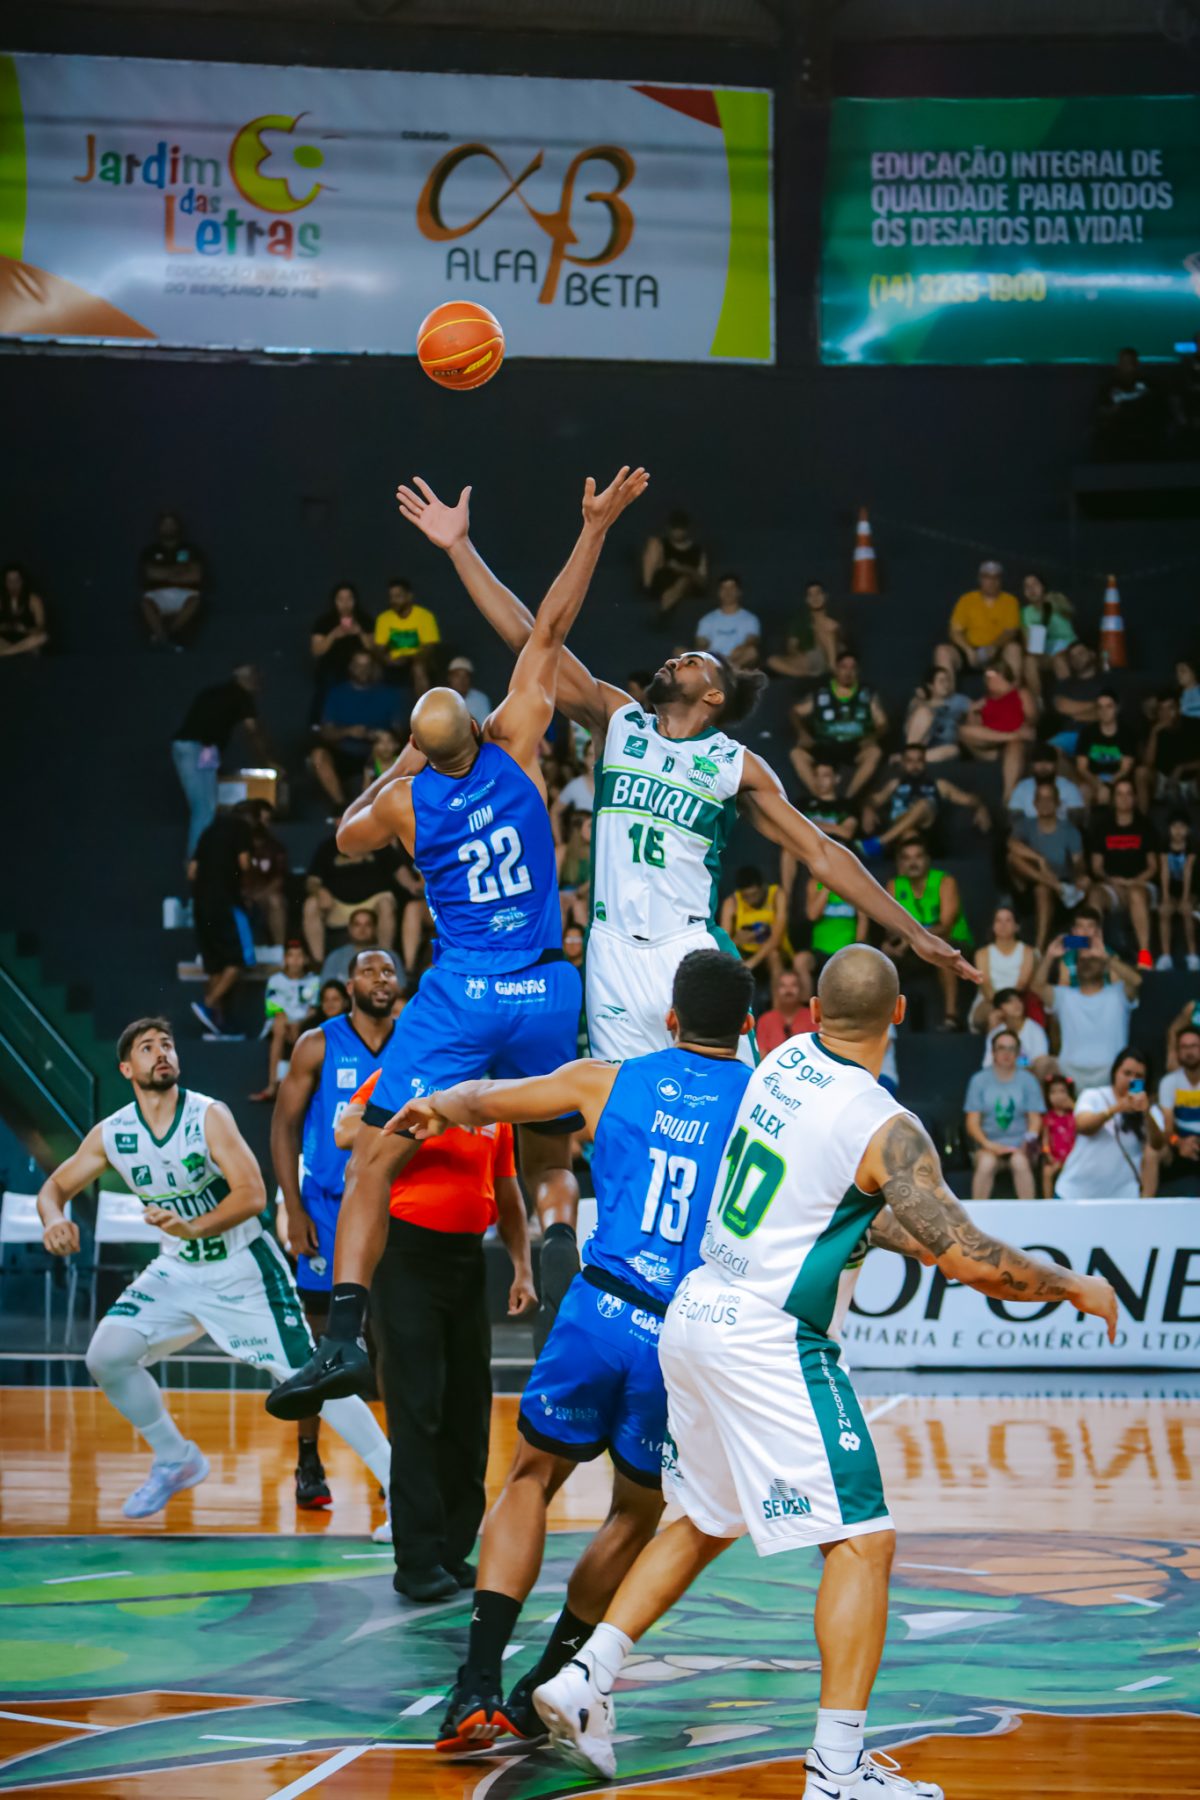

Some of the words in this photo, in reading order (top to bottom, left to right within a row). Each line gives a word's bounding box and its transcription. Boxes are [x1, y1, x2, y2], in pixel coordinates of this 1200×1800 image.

[73, 134, 222, 189] Jardim
[870, 145, 1006, 184] EDUCAÇÃO
[1012, 151, 1126, 179] INTEGRAL
[1131, 149, 1163, 177] DE
[179, 187, 221, 215] das
[871, 184, 1009, 215] QUALIDADE
[1018, 182, 1086, 212] PARA
[1090, 182, 1174, 211] TODOS
[164, 194, 321, 259] Letras
[872, 218, 906, 247] OS
[910, 217, 1030, 246] DESAFIOS
[1034, 215, 1071, 245] DA
[1074, 215, 1144, 244] VIDA!
[446, 247, 537, 284] ALFA
[564, 272, 659, 308] BETA
[468, 804, 494, 833] TOM
[612, 775, 703, 828] BAURU
[628, 822, 667, 869] 16
[458, 826, 532, 903] 22
[651, 1110, 699, 1143] PAULO
[750, 1104, 786, 1139] ALEX
[640, 1147, 698, 1243] 13
[718, 1125, 787, 1239] 10
[179, 1236, 228, 1262] 35
[952, 1330, 963, 1348] E
[762, 1496, 812, 1519] SEVEN
